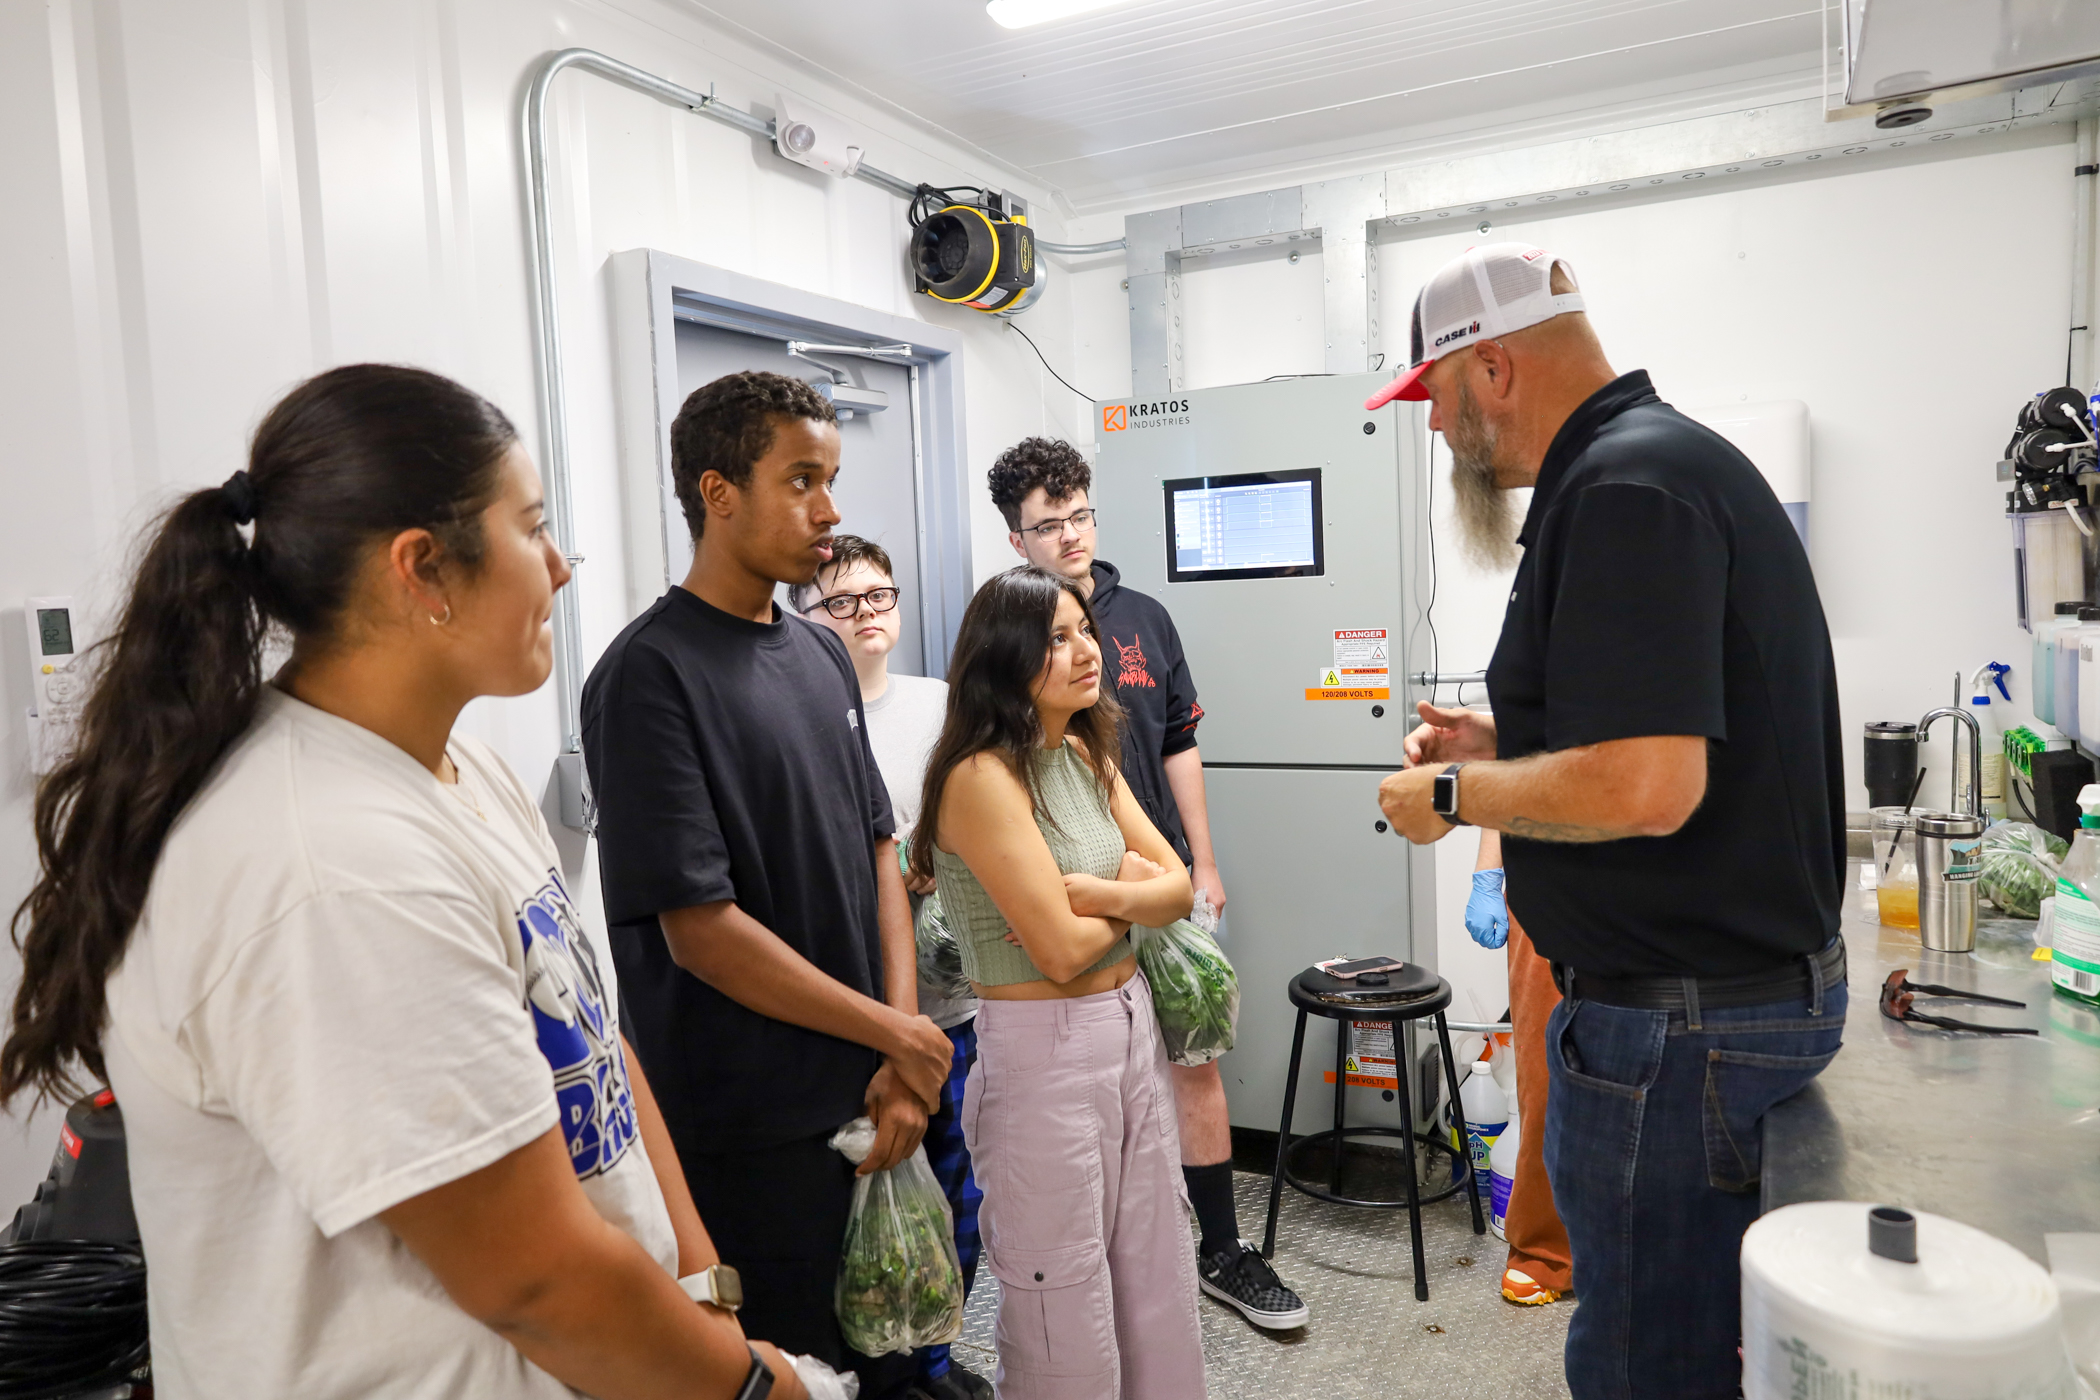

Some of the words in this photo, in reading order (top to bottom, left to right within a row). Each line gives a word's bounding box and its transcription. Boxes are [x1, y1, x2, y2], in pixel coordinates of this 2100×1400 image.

[1435, 327, 1467, 347] CASE
[1130, 400, 1188, 417] KRATOS
[1130, 416, 1190, 429] INDUSTRIES
[43, 628, 60, 642] 62
[1364, 1022, 1392, 1030] DANGE
